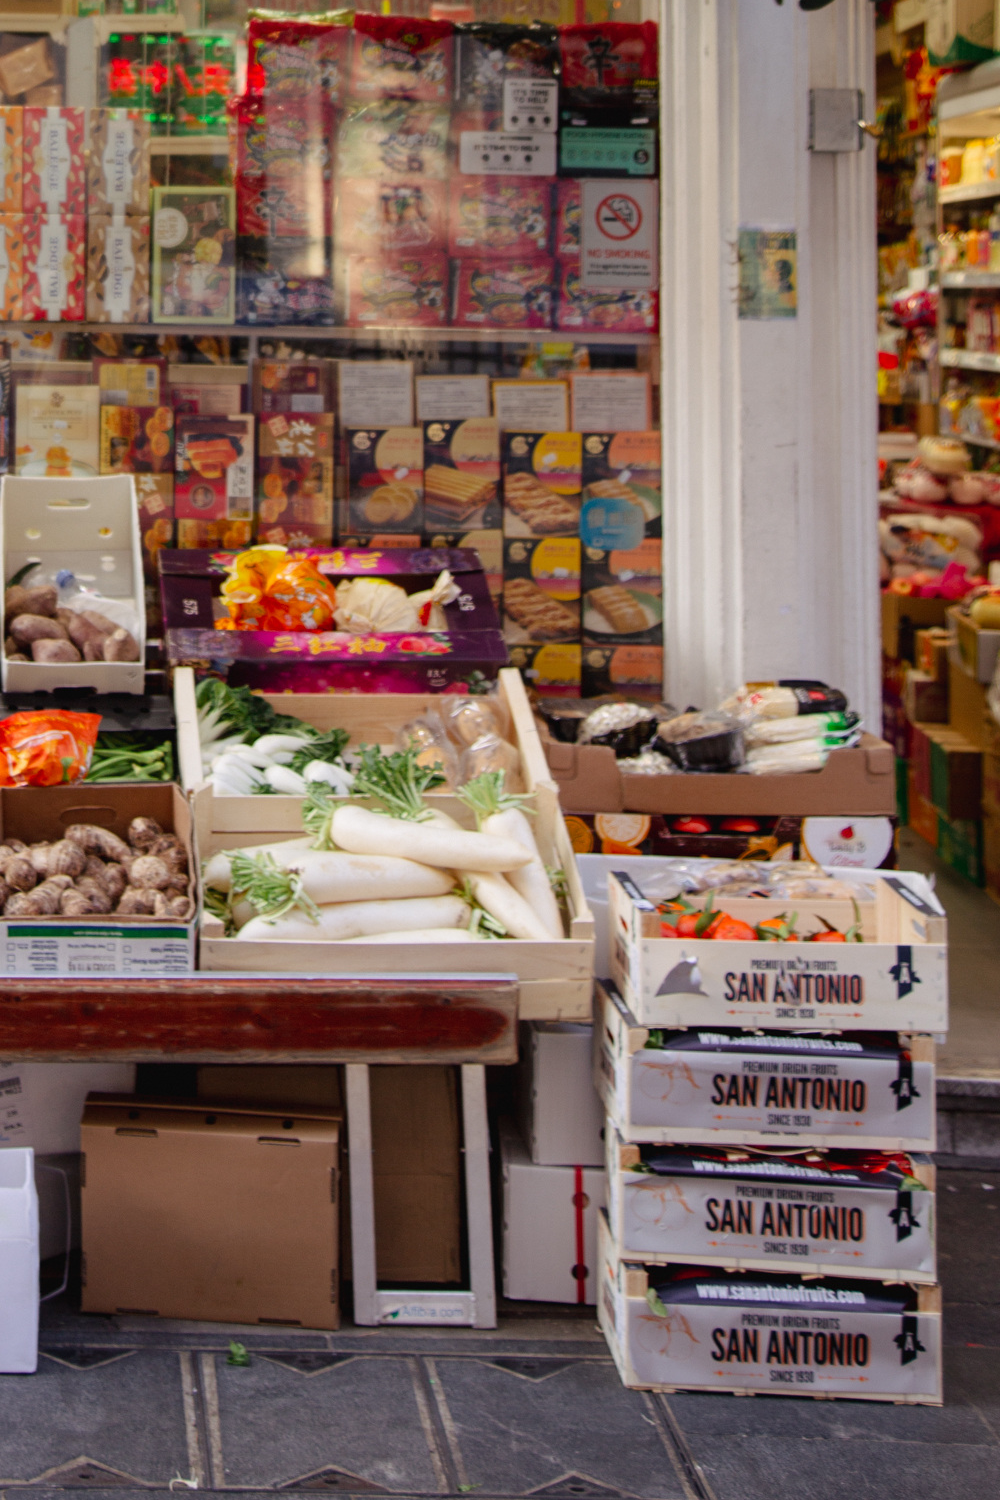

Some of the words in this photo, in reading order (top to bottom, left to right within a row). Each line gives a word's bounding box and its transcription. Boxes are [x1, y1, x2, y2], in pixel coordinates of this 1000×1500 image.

[588, 250, 602, 260] NO
[604, 250, 650, 260] SMOKING
[786, 960, 810, 971] ORIN
[724, 972, 766, 1002] SAN
[773, 973, 866, 1005] ANTONIO
[712, 1073, 758, 1107] SAN
[765, 1076, 866, 1113] ANTONIO
[705, 1197, 753, 1236] SAN
[761, 1203, 865, 1243] ANTONIO
[711, 1327, 758, 1363] SAN
[766, 1331, 870, 1367] ANTONIO
